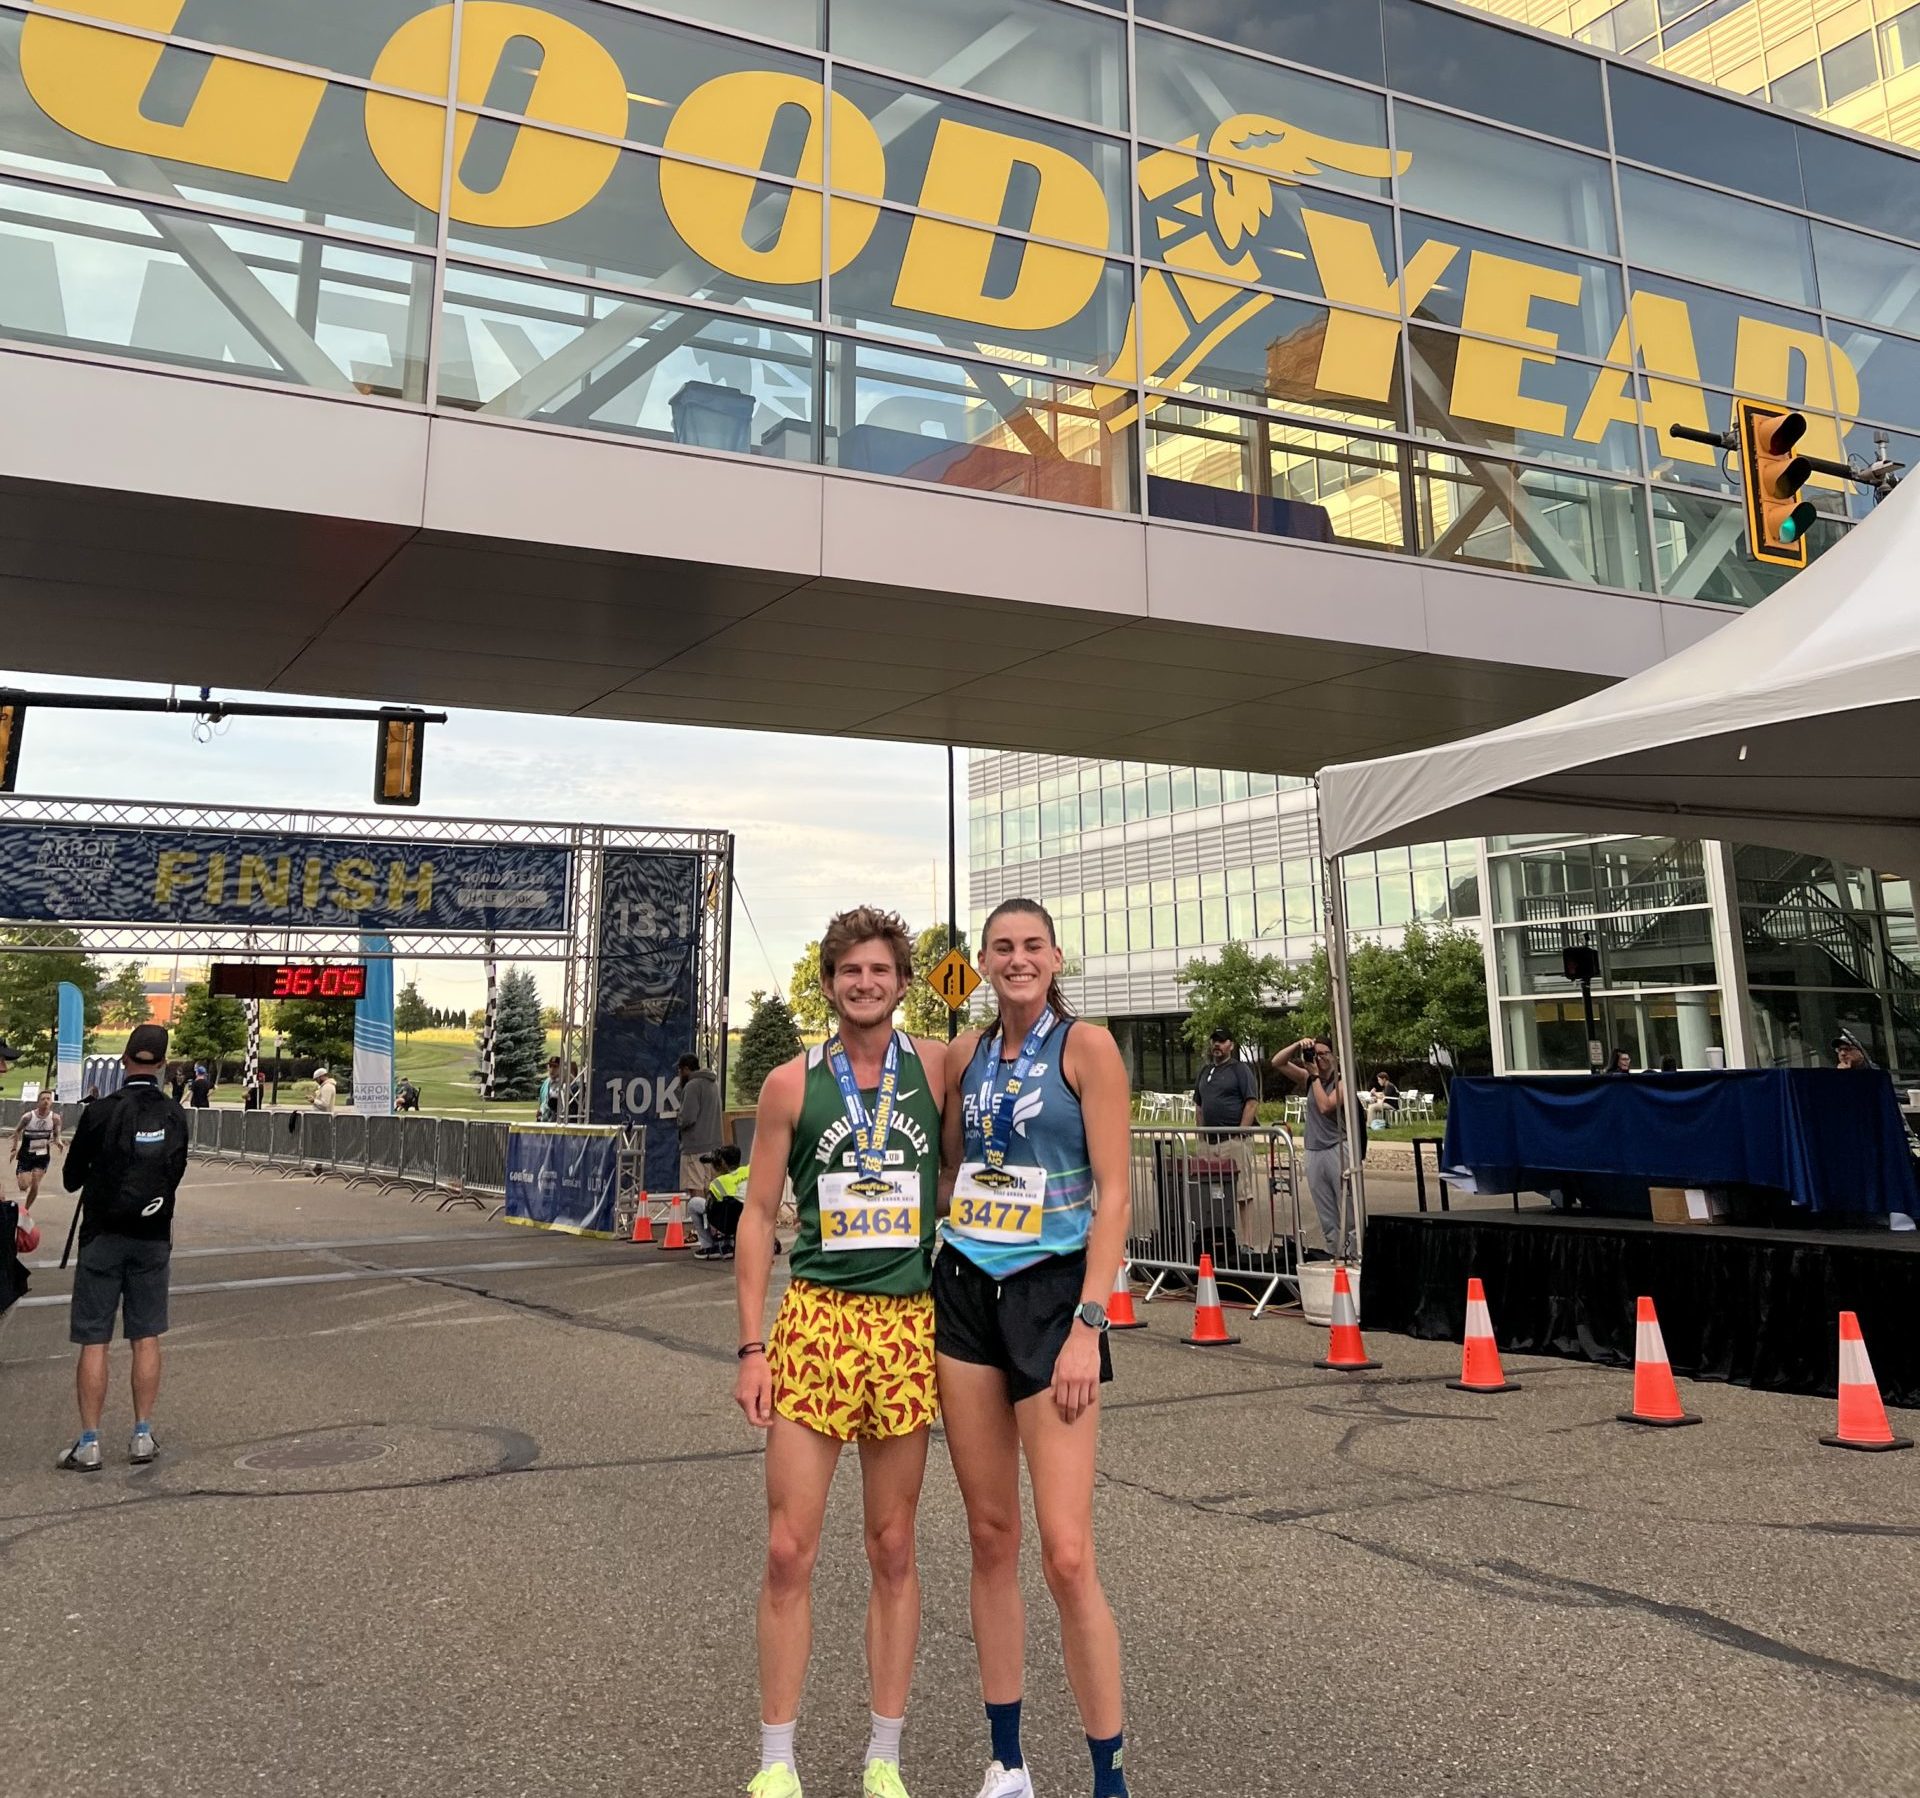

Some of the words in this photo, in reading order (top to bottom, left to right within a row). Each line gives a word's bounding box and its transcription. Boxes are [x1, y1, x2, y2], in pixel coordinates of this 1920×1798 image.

[36, 854, 114, 870] MARATHON
[38, 839, 116, 857] AKRON
[154, 850, 434, 913] FINISH
[613, 902, 689, 938] 13.1
[606, 1076, 681, 1114] 10K
[882, 1072, 896, 1094] 10K
[815, 1109, 875, 1164] MERRI
[871, 1094, 892, 1150] FINISHER
[830, 1208, 912, 1236] 3464
[958, 1200, 1032, 1230] 3477
